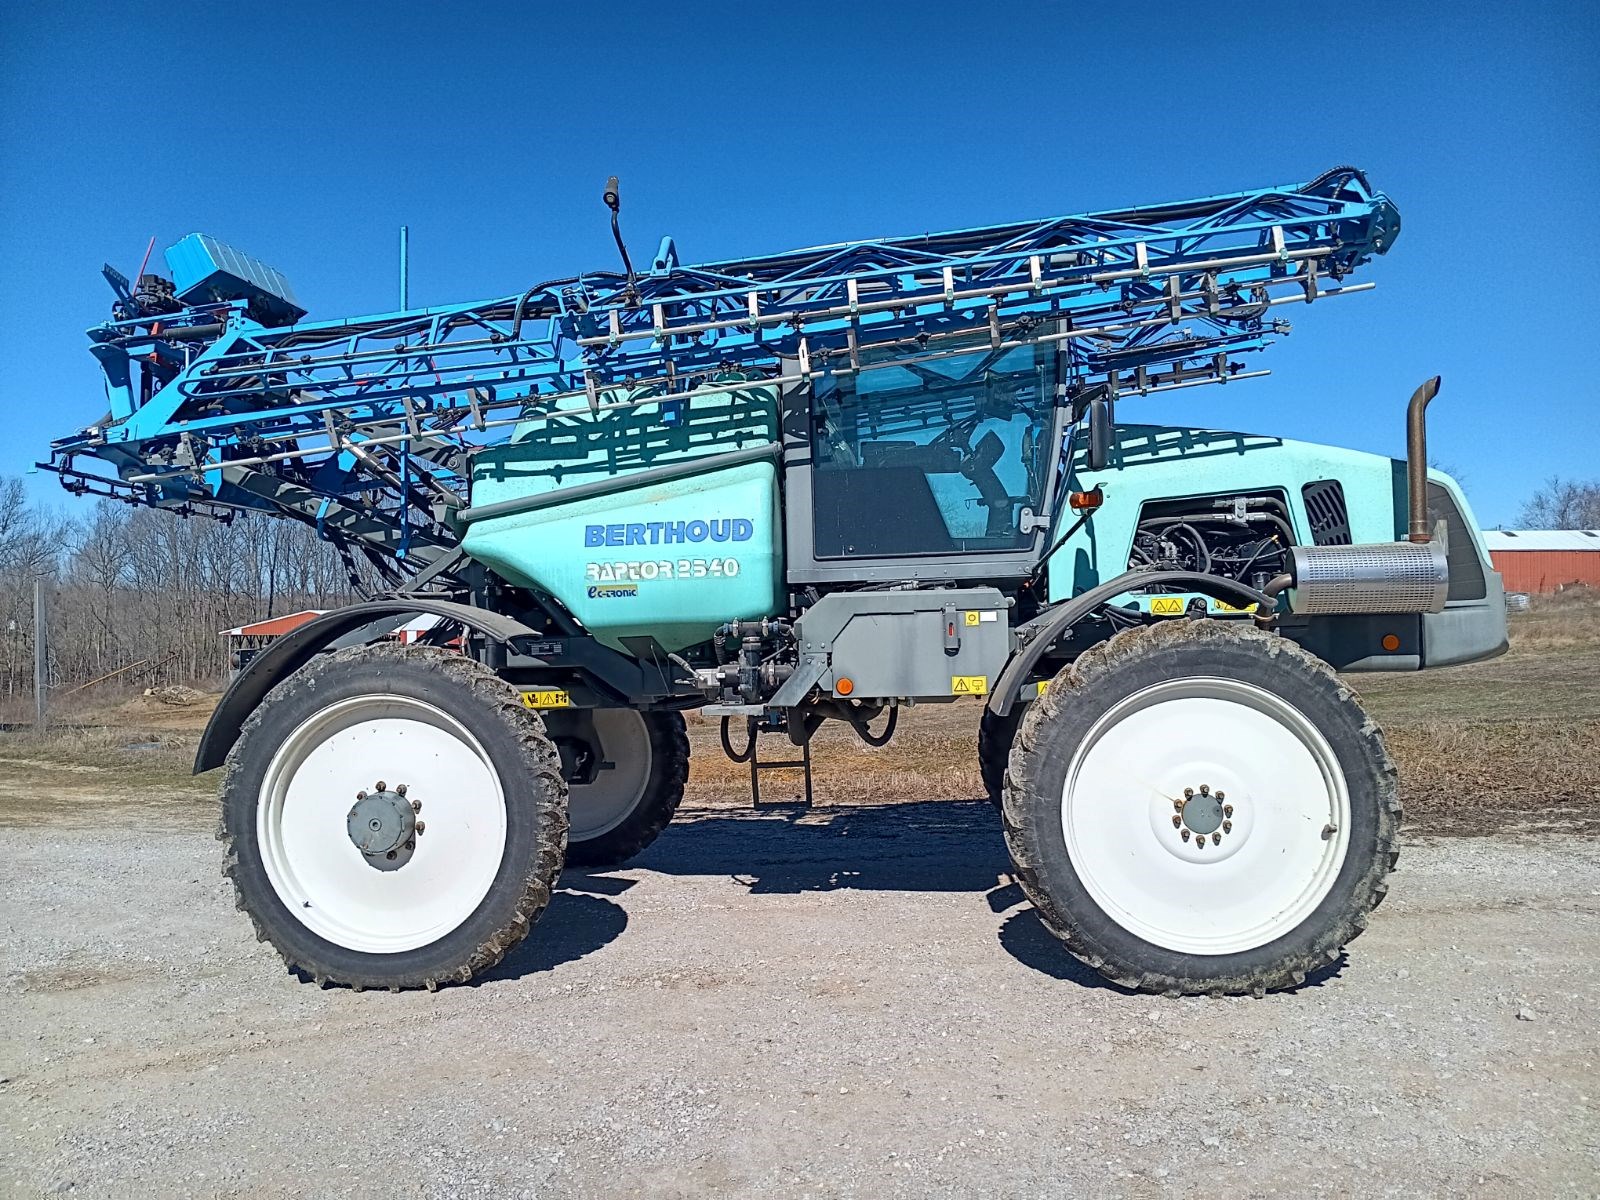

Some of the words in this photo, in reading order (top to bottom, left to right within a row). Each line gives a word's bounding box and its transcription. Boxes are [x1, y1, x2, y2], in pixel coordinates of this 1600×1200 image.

[584, 518, 754, 547] BERTHOUD
[586, 560, 674, 581] RAPTOR
[677, 557, 740, 578] 2540
